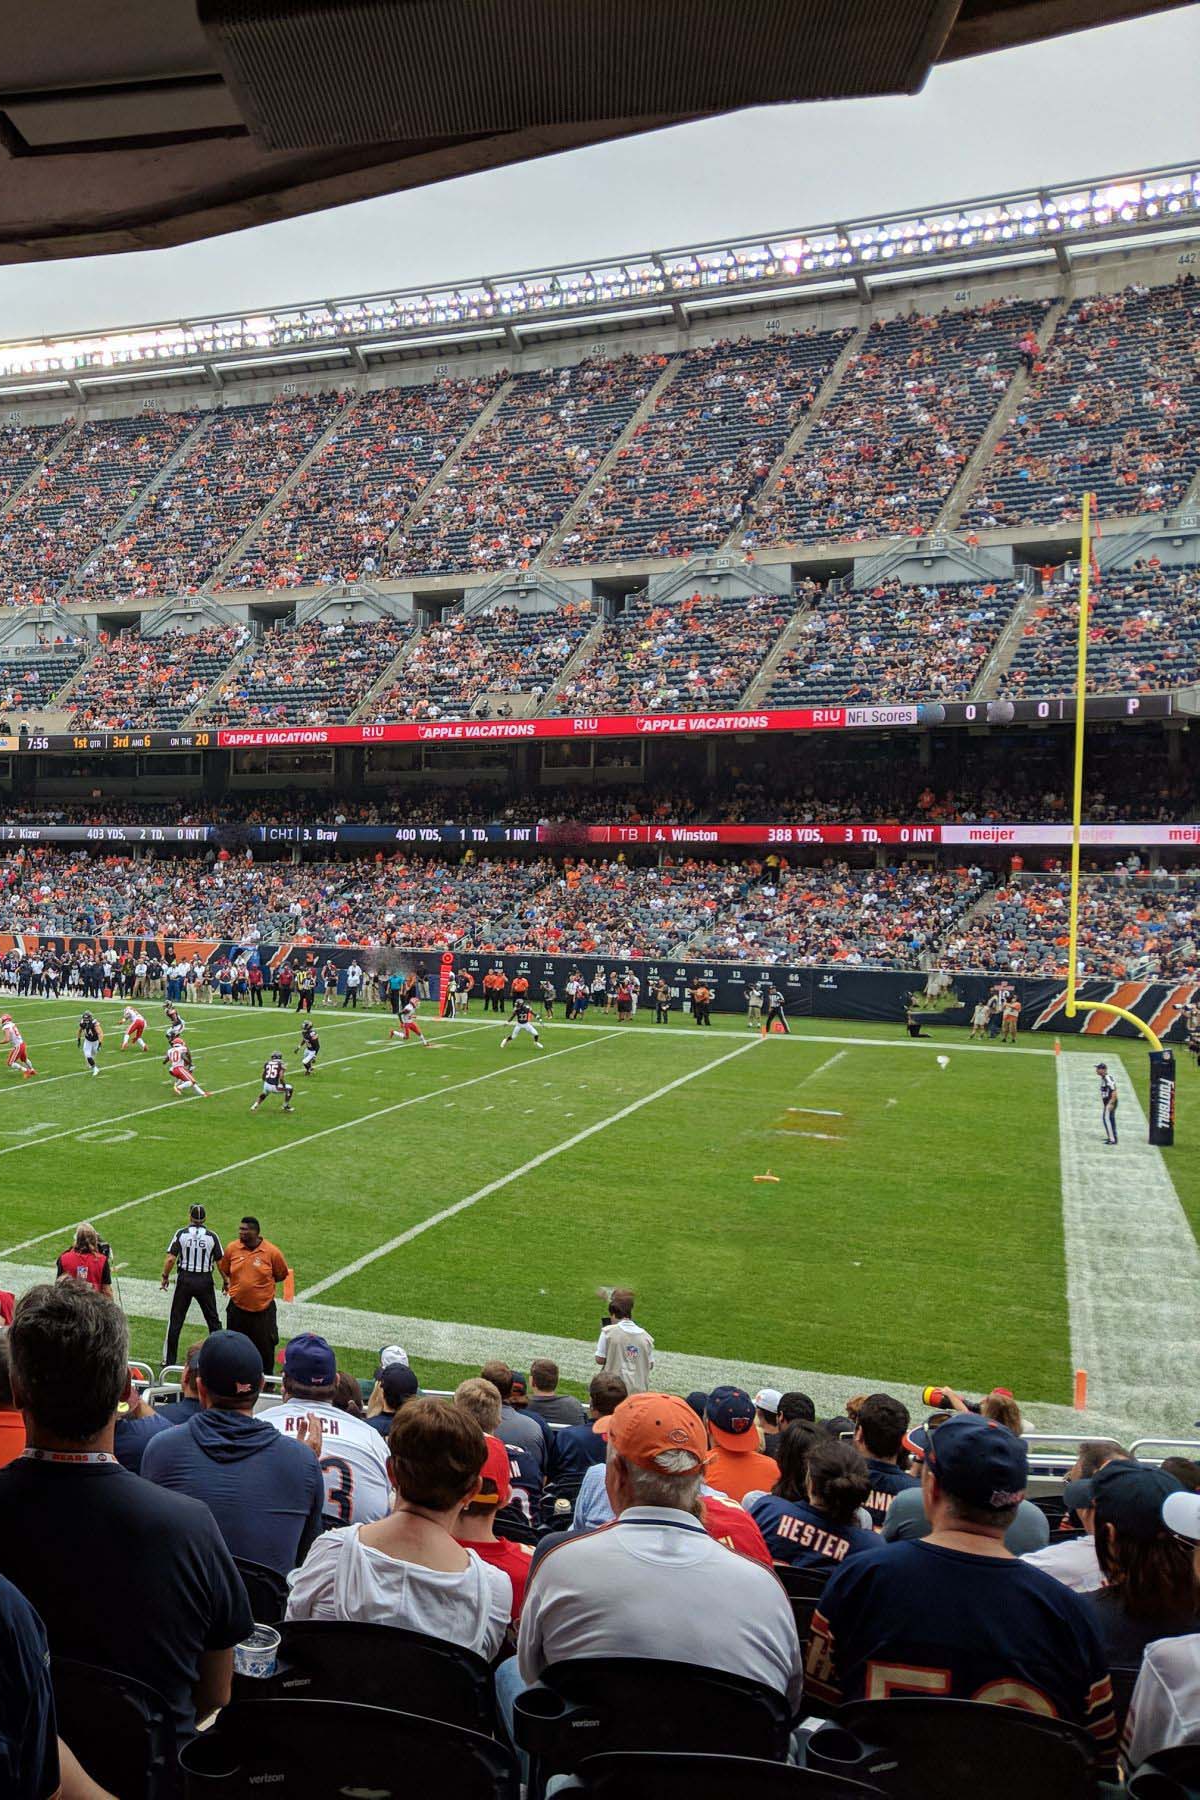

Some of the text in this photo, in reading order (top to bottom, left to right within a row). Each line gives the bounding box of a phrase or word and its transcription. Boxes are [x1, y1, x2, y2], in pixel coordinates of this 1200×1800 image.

[965, 704, 976, 720] 0
[1038, 702, 1049, 717] 0
[1127, 698, 1139, 714] P
[813, 711, 841, 721] RIU
[848, 709, 912, 723] NFL Scores
[574, 719, 598, 729] RIU
[643, 716, 769, 731] APPLE VACATIONS
[228, 731, 328, 744] APPLE VACATIONS
[362, 727, 384, 736] RIU
[424, 724, 535, 738] APPLE VACATIONS
[27, 737, 49, 749] 7:56
[73, 737, 88, 748] 1st
[112, 735, 129, 748] 3rd
[144, 735, 151, 747] 6
[170, 738, 180, 746] ON
[181, 737, 192, 746] THE
[195, 734, 209, 745] 20
[8, 829, 16, 838] 2.
[19, 829, 41, 839] Kizer
[87, 829, 104, 839] 403
[140, 829, 146, 839] 2
[177, 829, 184, 839] 0
[185, 829, 200, 839] INT
[270, 829, 293, 839] CHI
[303, 829, 312, 839] 3.
[317, 829, 338, 842] Bray
[396, 829, 416, 840] 400
[420, 829, 442, 842] YDS,
[459, 830, 465, 840] 1
[472, 830, 489, 842] TD,
[513, 830, 531, 840] INT
[618, 829, 934, 843] TB 4. Winston 388 YDS, 3 TD, 0 INT
[969, 827, 1015, 843] meijer
[265, 1063, 278, 1079] 35
[1157, 1077, 1175, 1129] FOOTBALL
[188, 1239, 207, 1249] 116
[285, 1417, 339, 1436] ROCH
[52, 1453, 89, 1462] BEARS
[776, 1514, 851, 1562] HESTER
[282, 1678, 312, 1688] verizon
[571, 1719, 601, 1728] verizon
[249, 1772, 285, 1784] verizon
